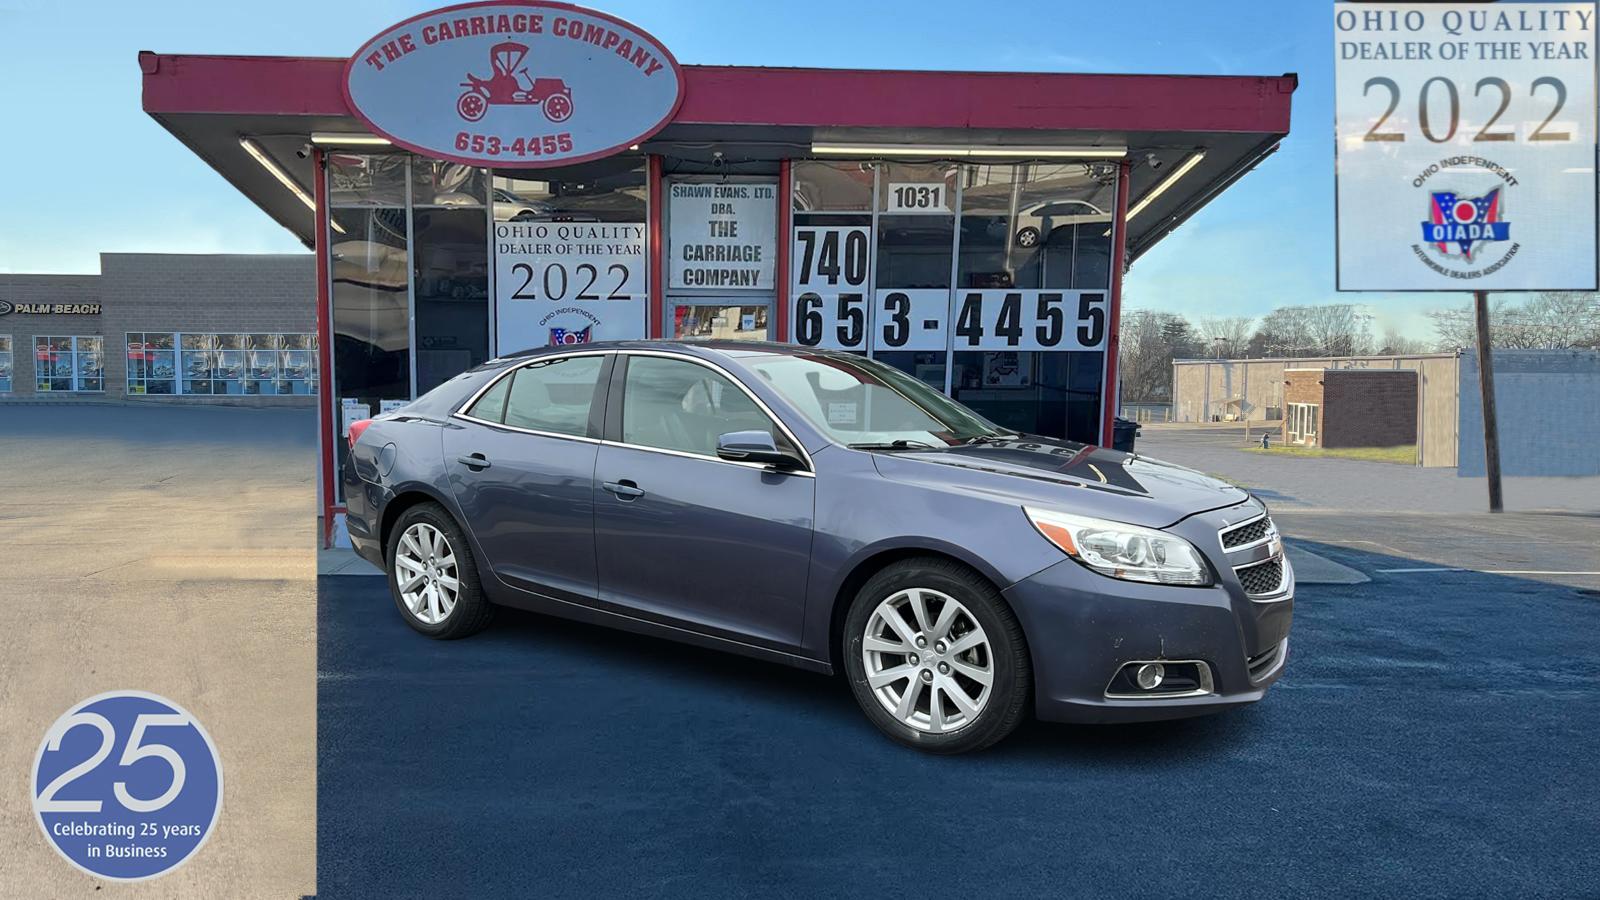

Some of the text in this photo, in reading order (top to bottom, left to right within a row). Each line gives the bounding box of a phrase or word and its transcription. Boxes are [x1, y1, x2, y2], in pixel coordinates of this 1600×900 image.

[1336, 10, 1593, 35] OHIO QUALITY
[365, 14, 664, 77] THE CARRIAGE COMPANY
[1340, 42, 1589, 60] DEALER OF THE YEAR
[1362, 76, 1571, 143] 2022
[455, 132, 573, 156] 653-4455
[1412, 156, 1519, 188] OHIO INDEPENDENT
[672, 185, 712, 198] SHAWN
[754, 187, 774, 199] LTD.
[894, 187, 940, 208] 1031
[711, 203, 736, 215] DBA.
[497, 226, 644, 241] OHIO QUALITY
[709, 220, 738, 238] THE
[1432, 223, 1495, 240] OIADA
[499, 243, 641, 255] DEALER OF THE YEAR
[683, 244, 762, 262] CARRIAGE
[796, 230, 867, 287] 740
[511, 263, 631, 301] 2022
[683, 268, 760, 286] COMPANY
[14, 303, 101, 314] PALM BEACH
[539, 307, 602, 327] OHIO INDEPENDENT
[795, 292, 1105, 348] 653-4455
